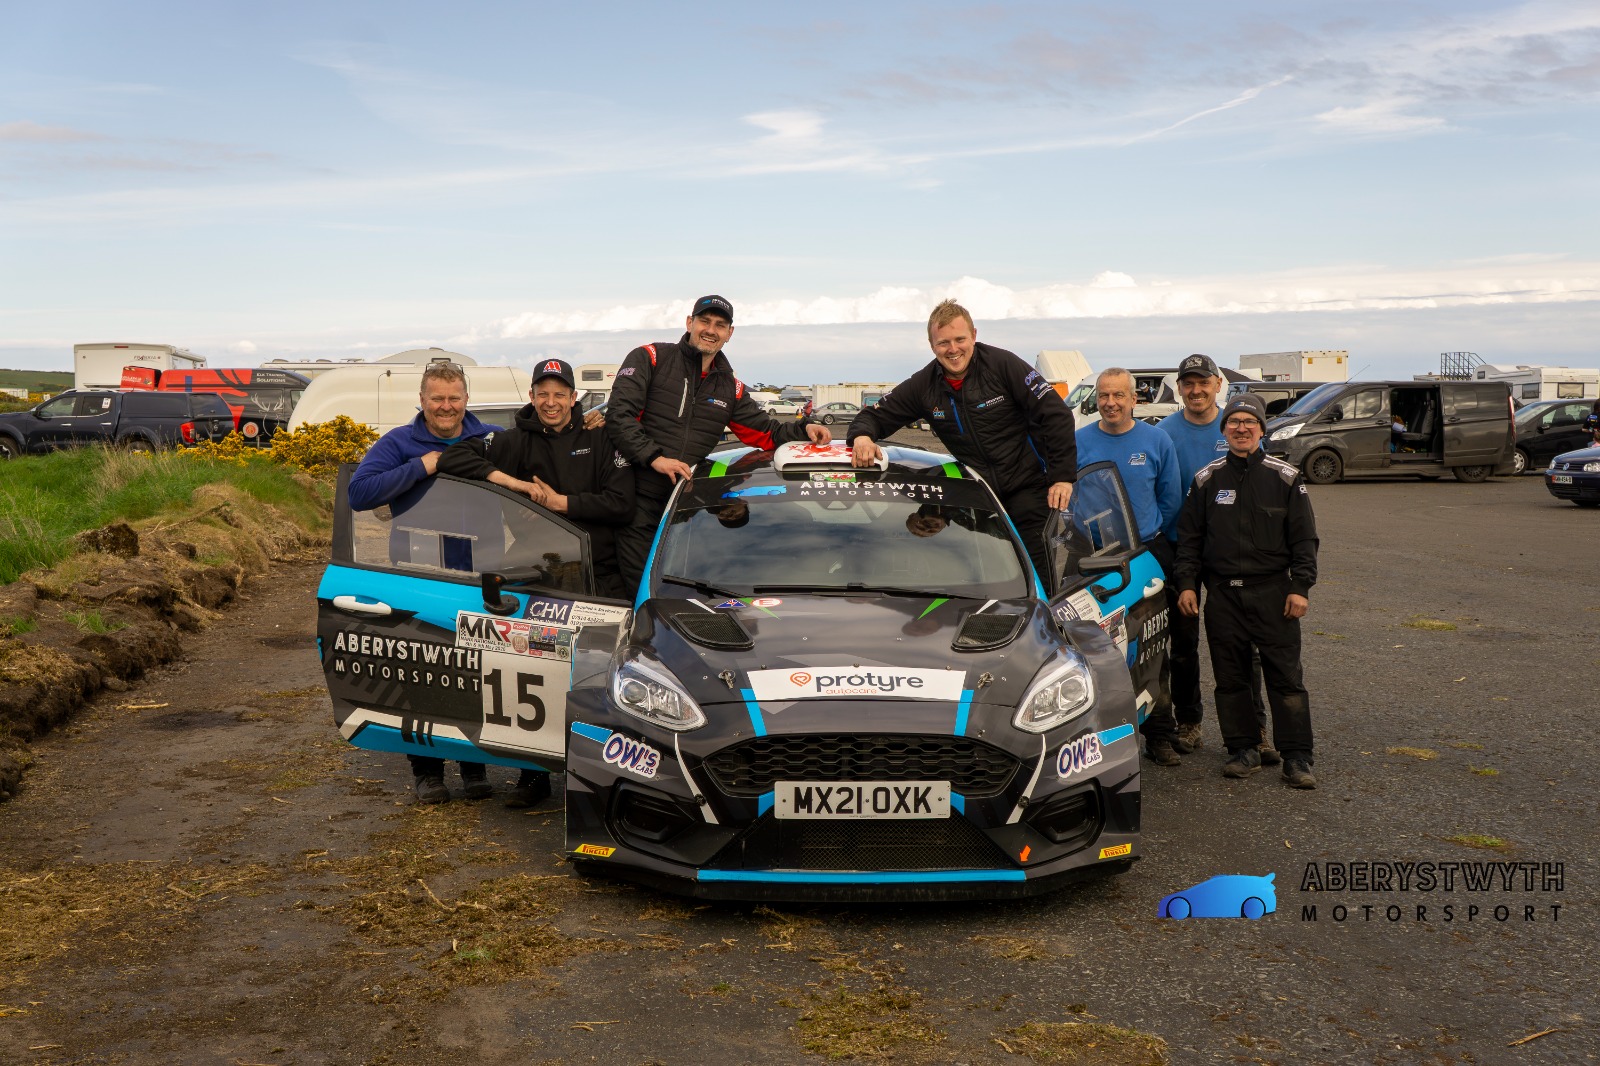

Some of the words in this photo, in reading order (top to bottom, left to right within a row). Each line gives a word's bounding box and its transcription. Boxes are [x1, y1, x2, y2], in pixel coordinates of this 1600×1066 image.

[800, 481, 943, 493] ABERYSTWYTH
[800, 489, 944, 500] MOTORSPORT
[529, 600, 569, 620] CHM
[334, 632, 479, 670] ABERYSTWYTH
[335, 659, 480, 692] MOTORSPORT
[815, 672, 924, 692] protyre
[484, 668, 546, 732] 15
[1087, 753, 1101, 764] CABS
[635, 764, 655, 775] CABS
[793, 786, 863, 815] MX21
[872, 786, 933, 815] OXK
[581, 844, 610, 856] PIRELLI
